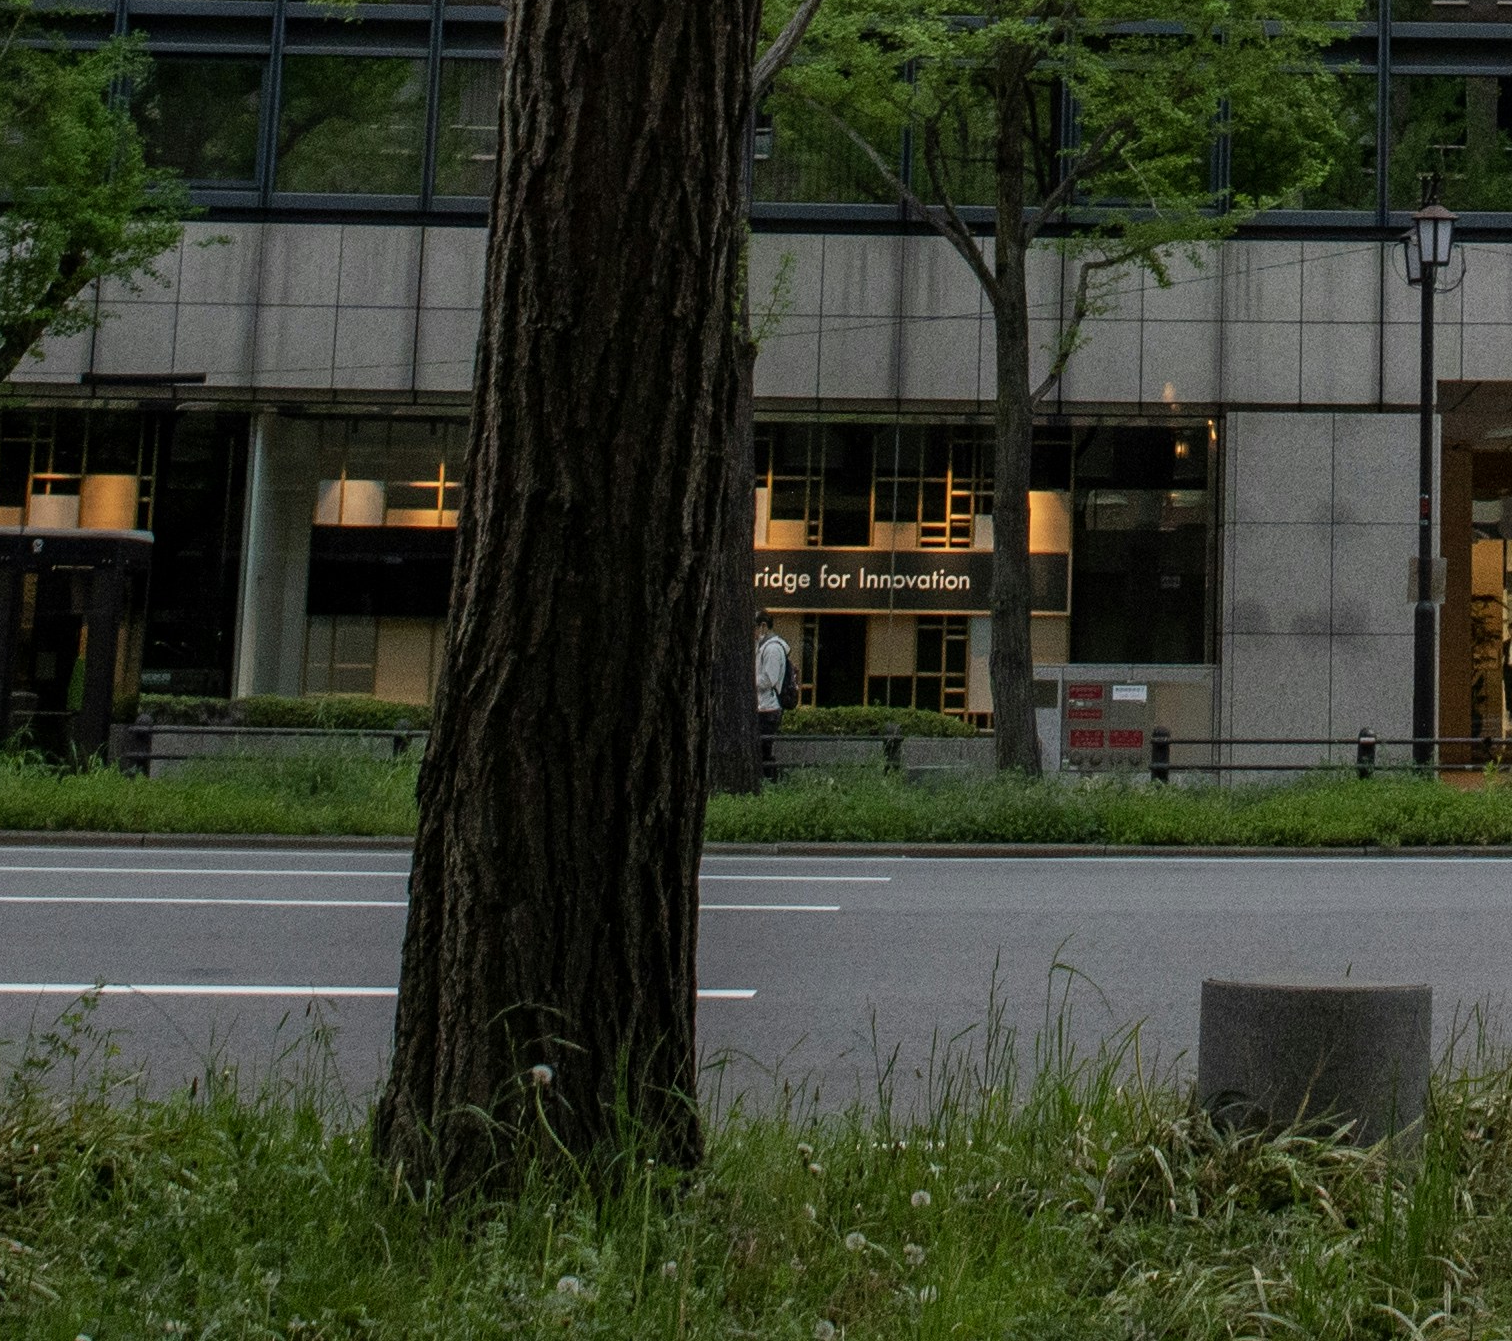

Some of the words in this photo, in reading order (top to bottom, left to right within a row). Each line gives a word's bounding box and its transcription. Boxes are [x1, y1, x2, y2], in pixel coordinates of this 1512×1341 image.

[754, 564, 811, 593] ridge
[819, 564, 851, 589] for
[859, 567, 971, 590] Innovation
